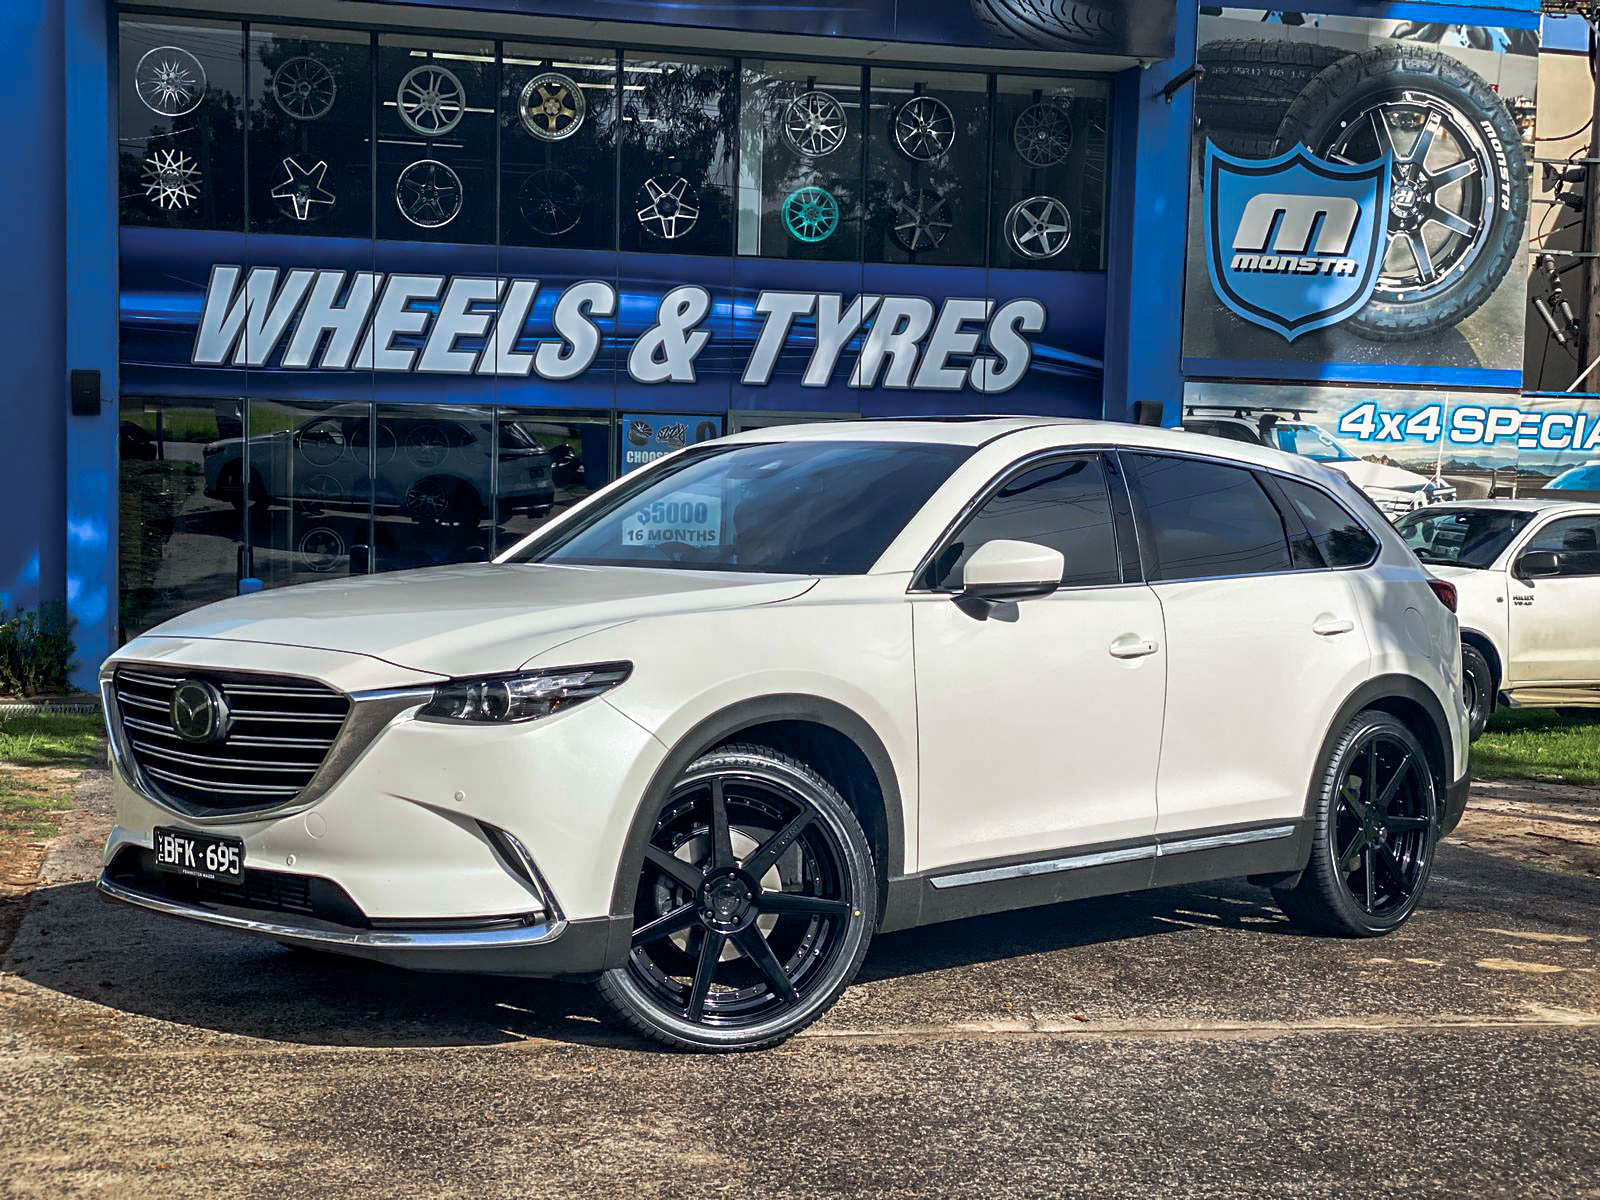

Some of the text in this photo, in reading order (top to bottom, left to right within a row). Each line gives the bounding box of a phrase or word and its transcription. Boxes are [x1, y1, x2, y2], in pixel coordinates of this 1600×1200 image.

[1480, 121, 1510, 211] MONSTA
[1230, 255, 1358, 276] MONSTA
[192, 264, 1047, 393] WHEELS & TYRES
[1339, 403, 1442, 442] 4x4
[636, 501, 708, 526] $5000
[627, 529, 717, 542] 16 MONTHS
